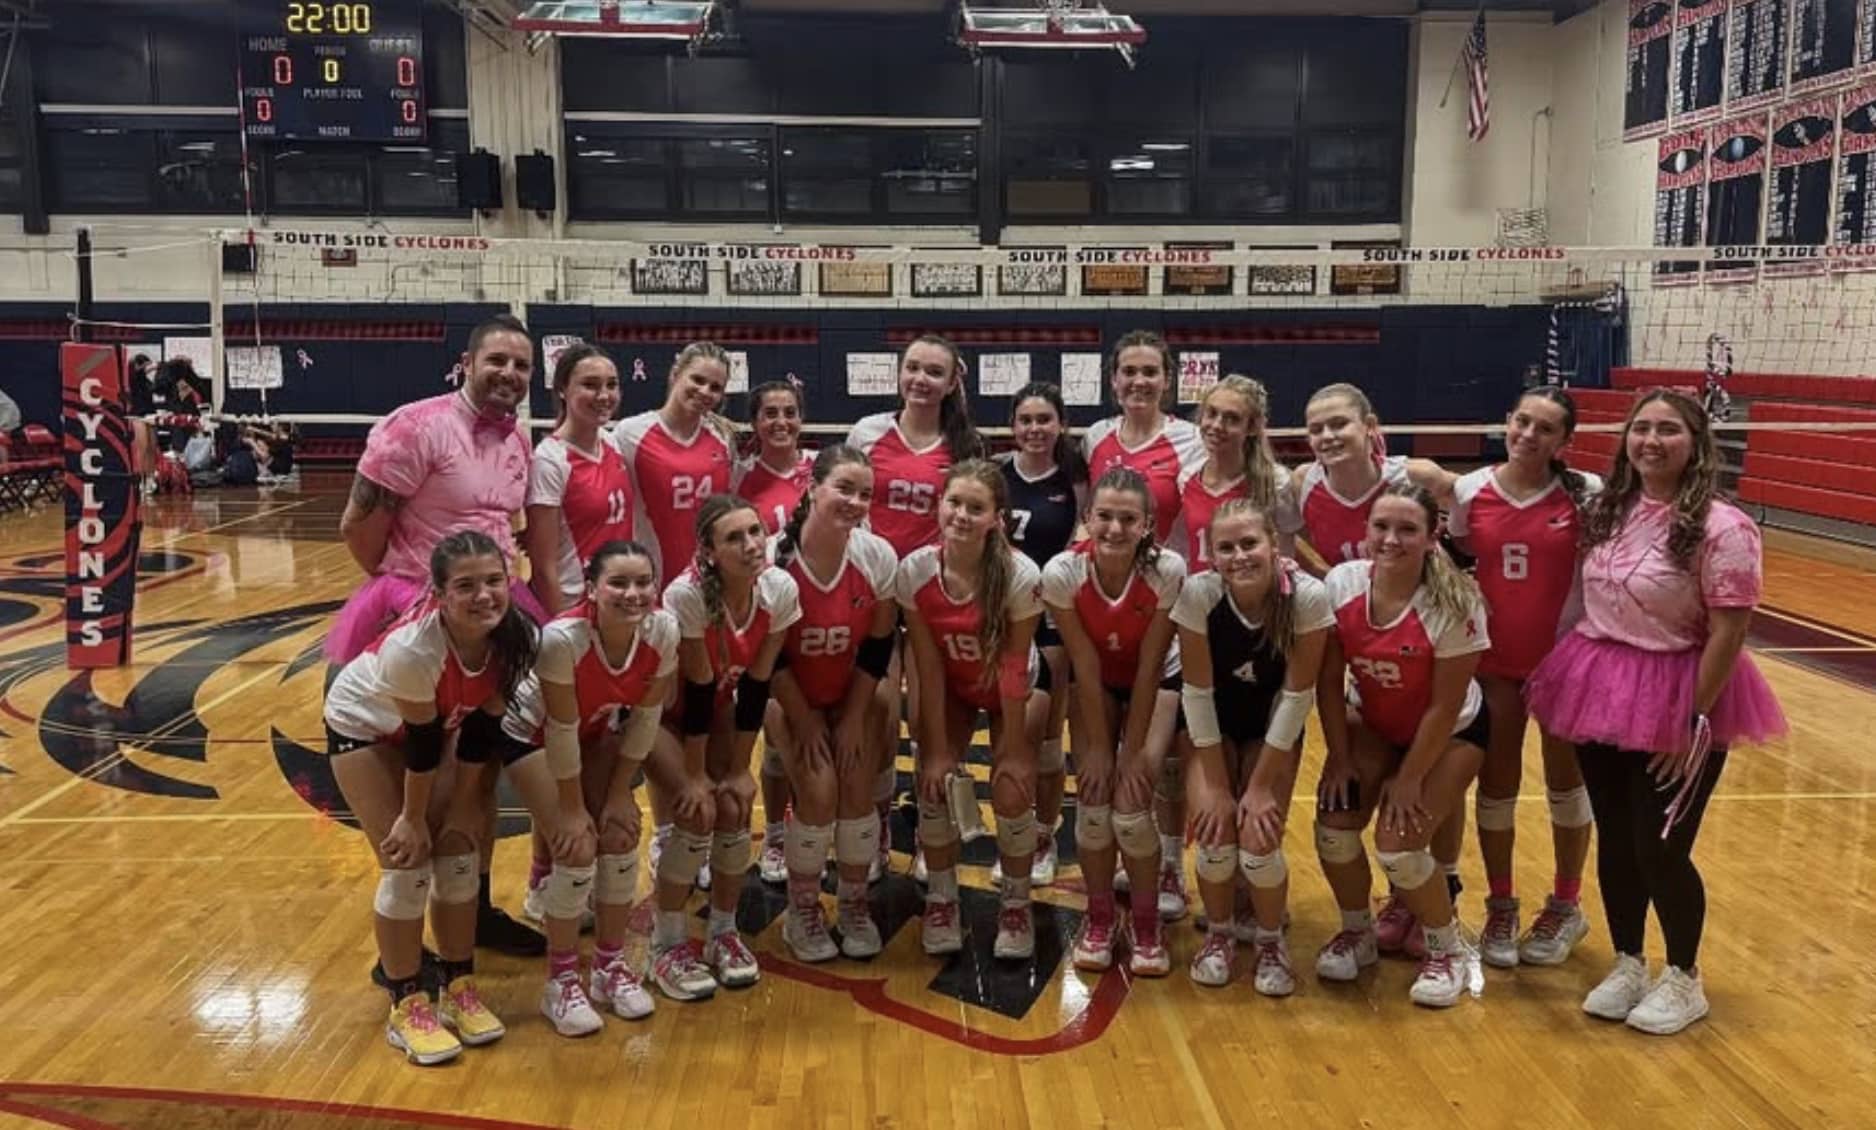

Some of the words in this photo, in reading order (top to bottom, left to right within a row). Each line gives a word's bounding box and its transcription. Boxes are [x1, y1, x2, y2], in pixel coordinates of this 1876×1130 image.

[287, 3, 371, 33] 22:00
[274, 55, 292, 85] 0
[323, 59, 339, 83] 0
[397, 57, 415, 86] 0
[256, 99, 272, 122] 0
[402, 99, 417, 123] 0
[273, 231, 336, 246] SOUTH
[343, 234, 389, 248] SIDE
[394, 236, 489, 250] CYCLONES
[648, 244, 710, 257] SOUTH
[717, 246, 760, 259] SIDE
[765, 247, 855, 261] CYCLONES
[1363, 249, 1422, 262] SOUTH
[1429, 249, 1471, 261] SIDE
[1476, 247, 1565, 260] CYCLONES
[1713, 247, 1772, 259] SOUTH
[1777, 246, 1818, 257] SIDE
[1008, 250, 1067, 262] SOUTH
[1075, 250, 1120, 263] SIDE
[1122, 250, 1211, 263] CYCLONES
[605, 488, 625, 525] 11
[672, 474, 713, 510] 24
[887, 478, 935, 515] 25
[78, 378, 106, 647] CYCLONES
[1011, 509, 1032, 540] 7
[1501, 542, 1529, 580] 6
[799, 625, 851, 657] 26
[942, 632, 982, 662] 19
[1106, 631, 1121, 649] 1
[1231, 660, 1257, 683] 4
